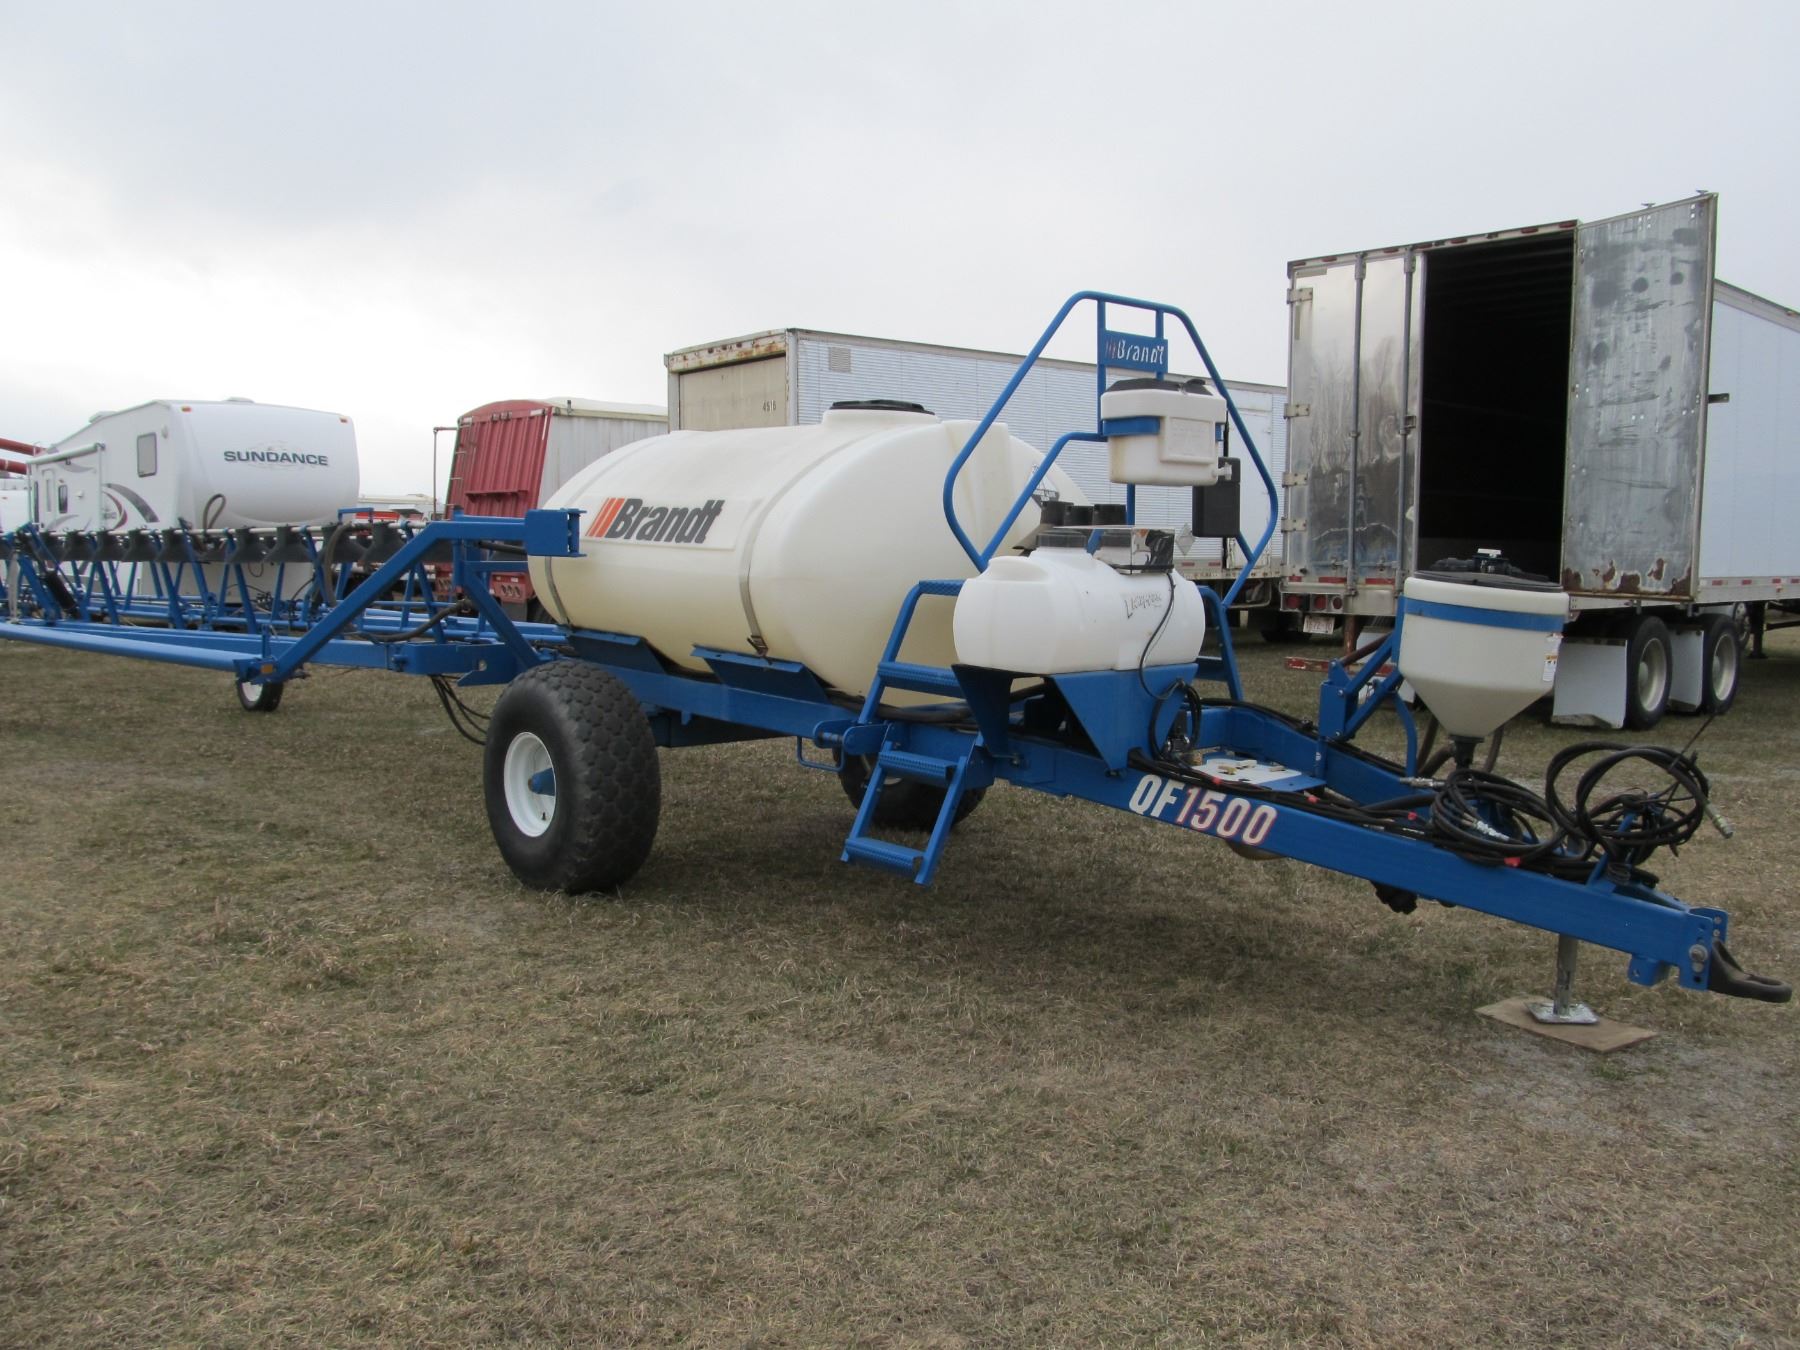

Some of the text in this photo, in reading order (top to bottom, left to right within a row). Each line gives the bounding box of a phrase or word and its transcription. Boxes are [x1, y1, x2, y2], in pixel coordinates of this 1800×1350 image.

[1117, 340, 1164, 365] Brandt
[223, 450, 329, 466] SUNDANCE
[604, 498, 726, 544] Brandt
[1128, 773, 1279, 846] QF1500
